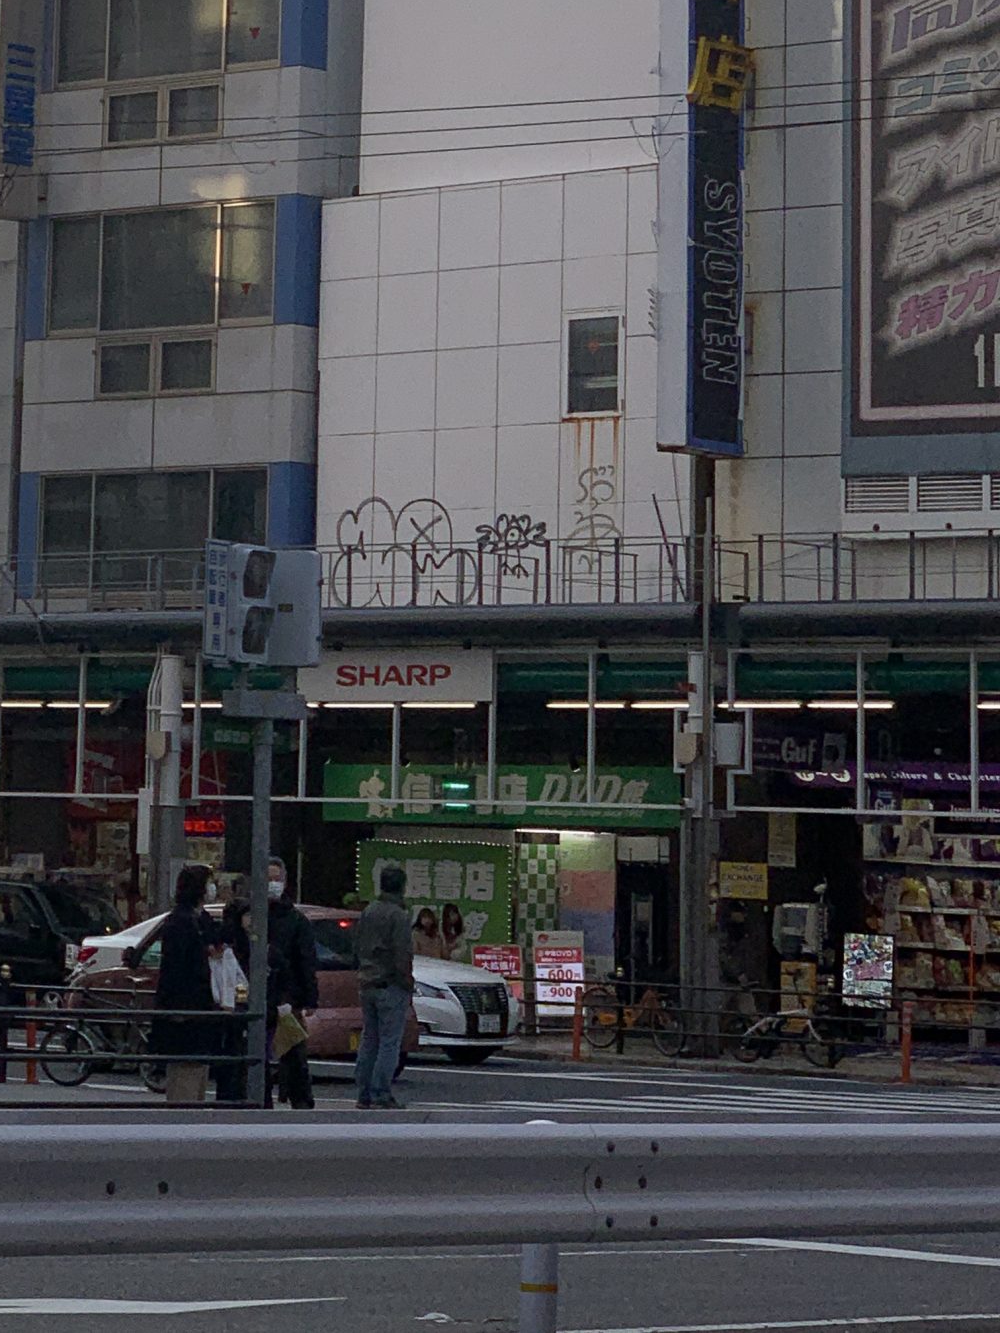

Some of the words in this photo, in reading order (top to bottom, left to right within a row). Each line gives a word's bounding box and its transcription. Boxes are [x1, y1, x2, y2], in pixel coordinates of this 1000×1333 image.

[703, 177, 740, 386] SYOTEN
[336, 664, 452, 687] SHARP
[550, 986, 573, 998] 900
